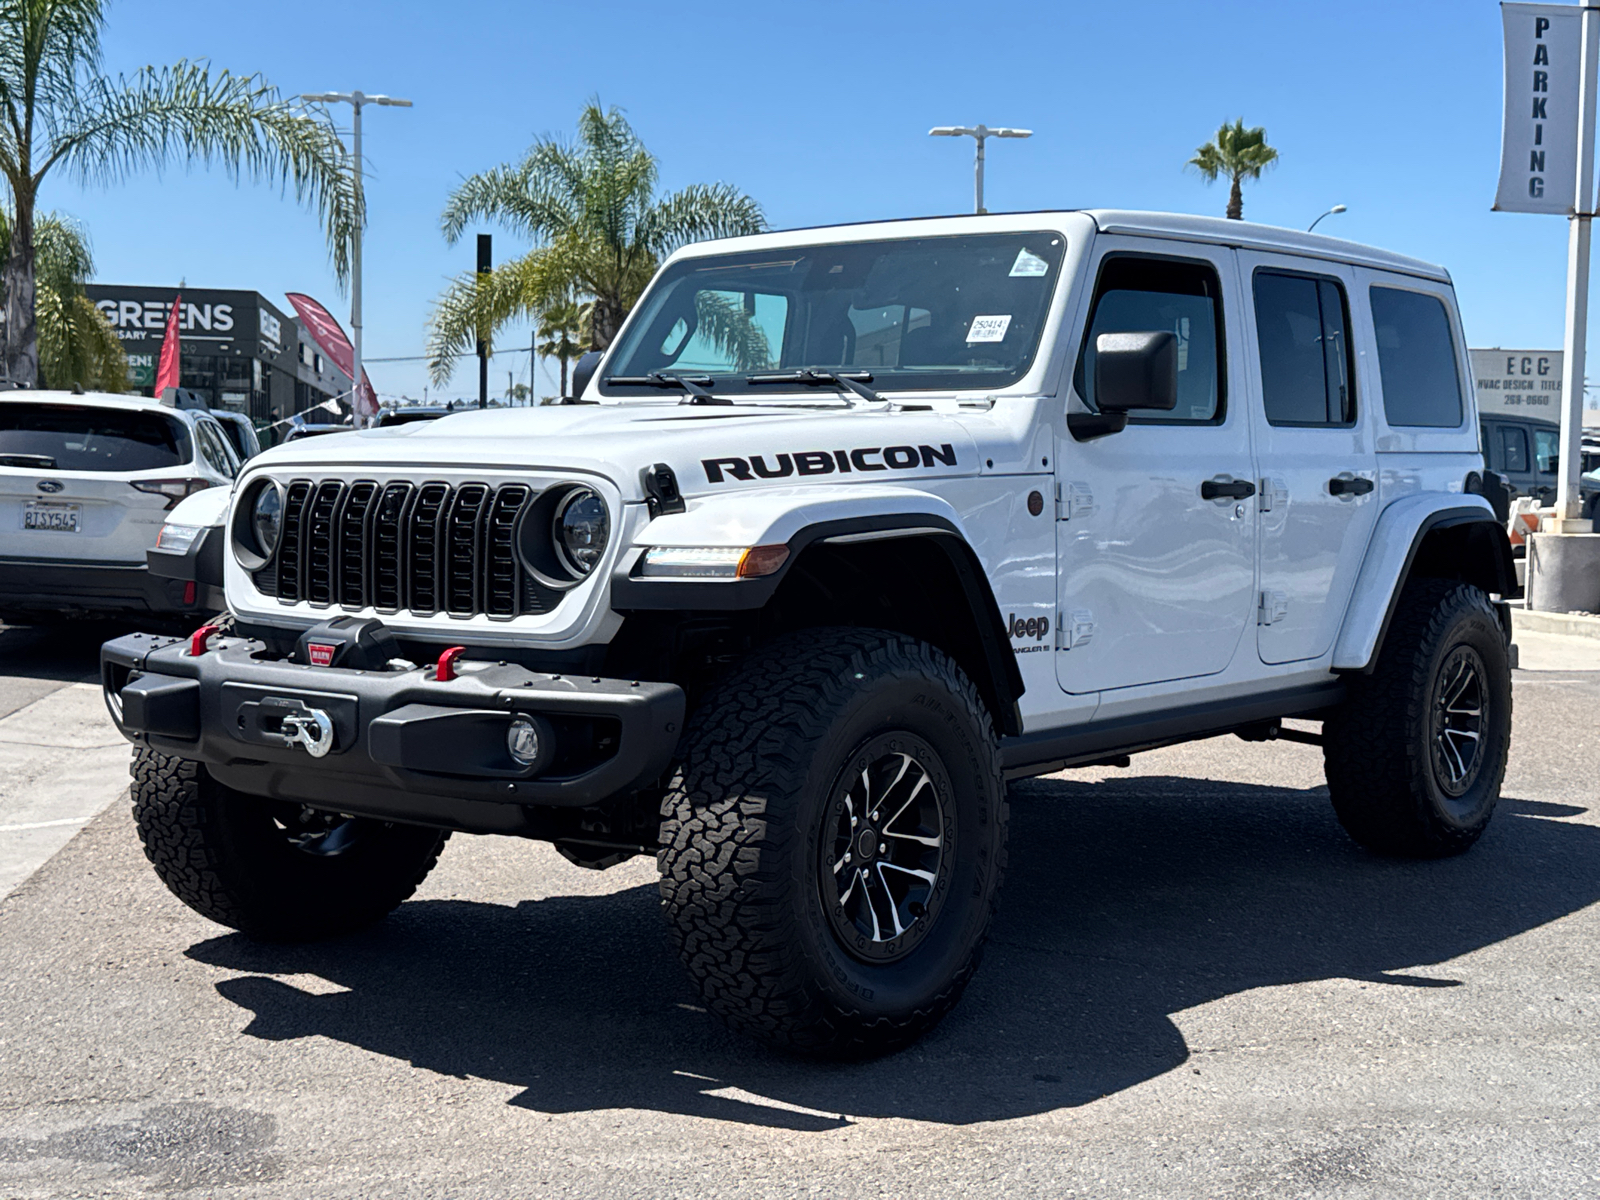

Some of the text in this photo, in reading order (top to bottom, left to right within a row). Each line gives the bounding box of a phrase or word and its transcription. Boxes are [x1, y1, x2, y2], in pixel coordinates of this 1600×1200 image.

[1528, 17, 1550, 199] PARKING
[94, 300, 234, 331] GREENS
[973, 319, 1003, 329] 250414
[1503, 379, 1534, 390] DESIGN
[700, 443, 958, 484] RUBICON
[1007, 613, 1050, 641] Jeep
